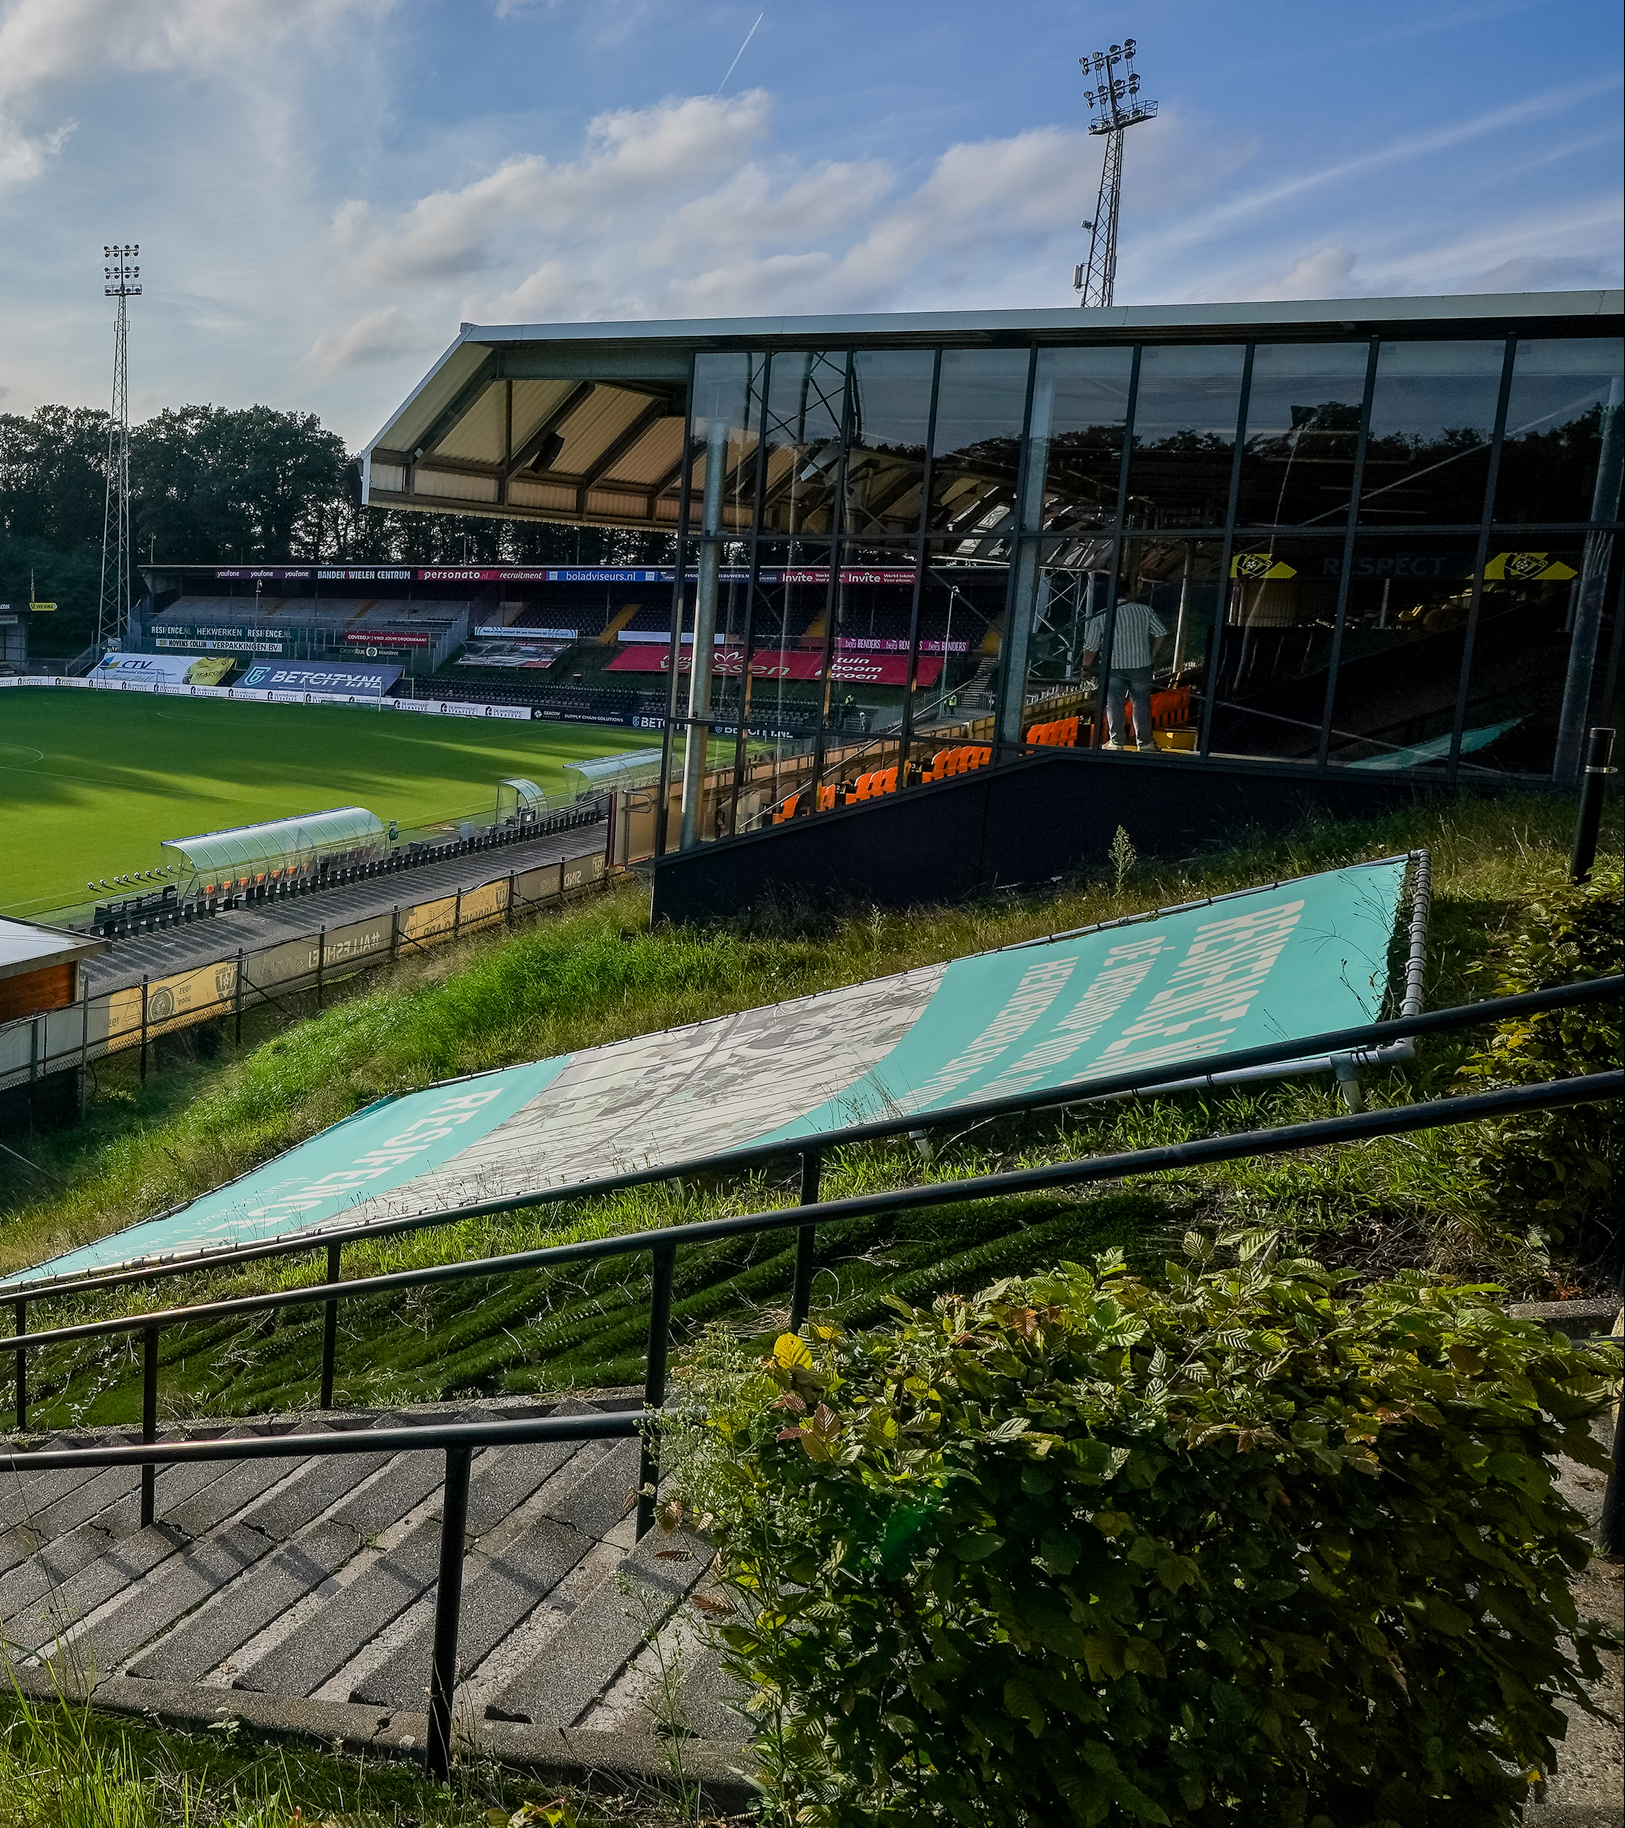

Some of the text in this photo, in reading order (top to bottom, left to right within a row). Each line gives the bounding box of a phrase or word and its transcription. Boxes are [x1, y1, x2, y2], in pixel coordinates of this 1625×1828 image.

[1322, 557, 1448, 576] RSPECT
[250, 570, 273, 578] youfone
[285, 570, 309, 578] youfone
[317, 571, 410, 579] BANDEN WIELEN CENTRUM
[566, 571, 636, 581] boladviseurs.nl
[196, 627, 243, 637] HEKWERKEN
[212, 641, 267, 651] VERPAKKINGEN
[268, 643, 278, 652] BV
[857, 639, 881, 649] BENDERS
[121, 660, 154, 669] CTV
[836, 656, 870, 665] tuin
[831, 664, 883, 673] boom
[270, 671, 382, 689] BETCITY.NL
[1101, 935, 1174, 967] DÉ
[1050, 956, 1156, 1032] WEBSHOP
[961, 955, 1080, 1053] HEKWERKEN
[992, 1024, 1103, 1078] VOOR
[931, 1045, 1010, 1076] EN
